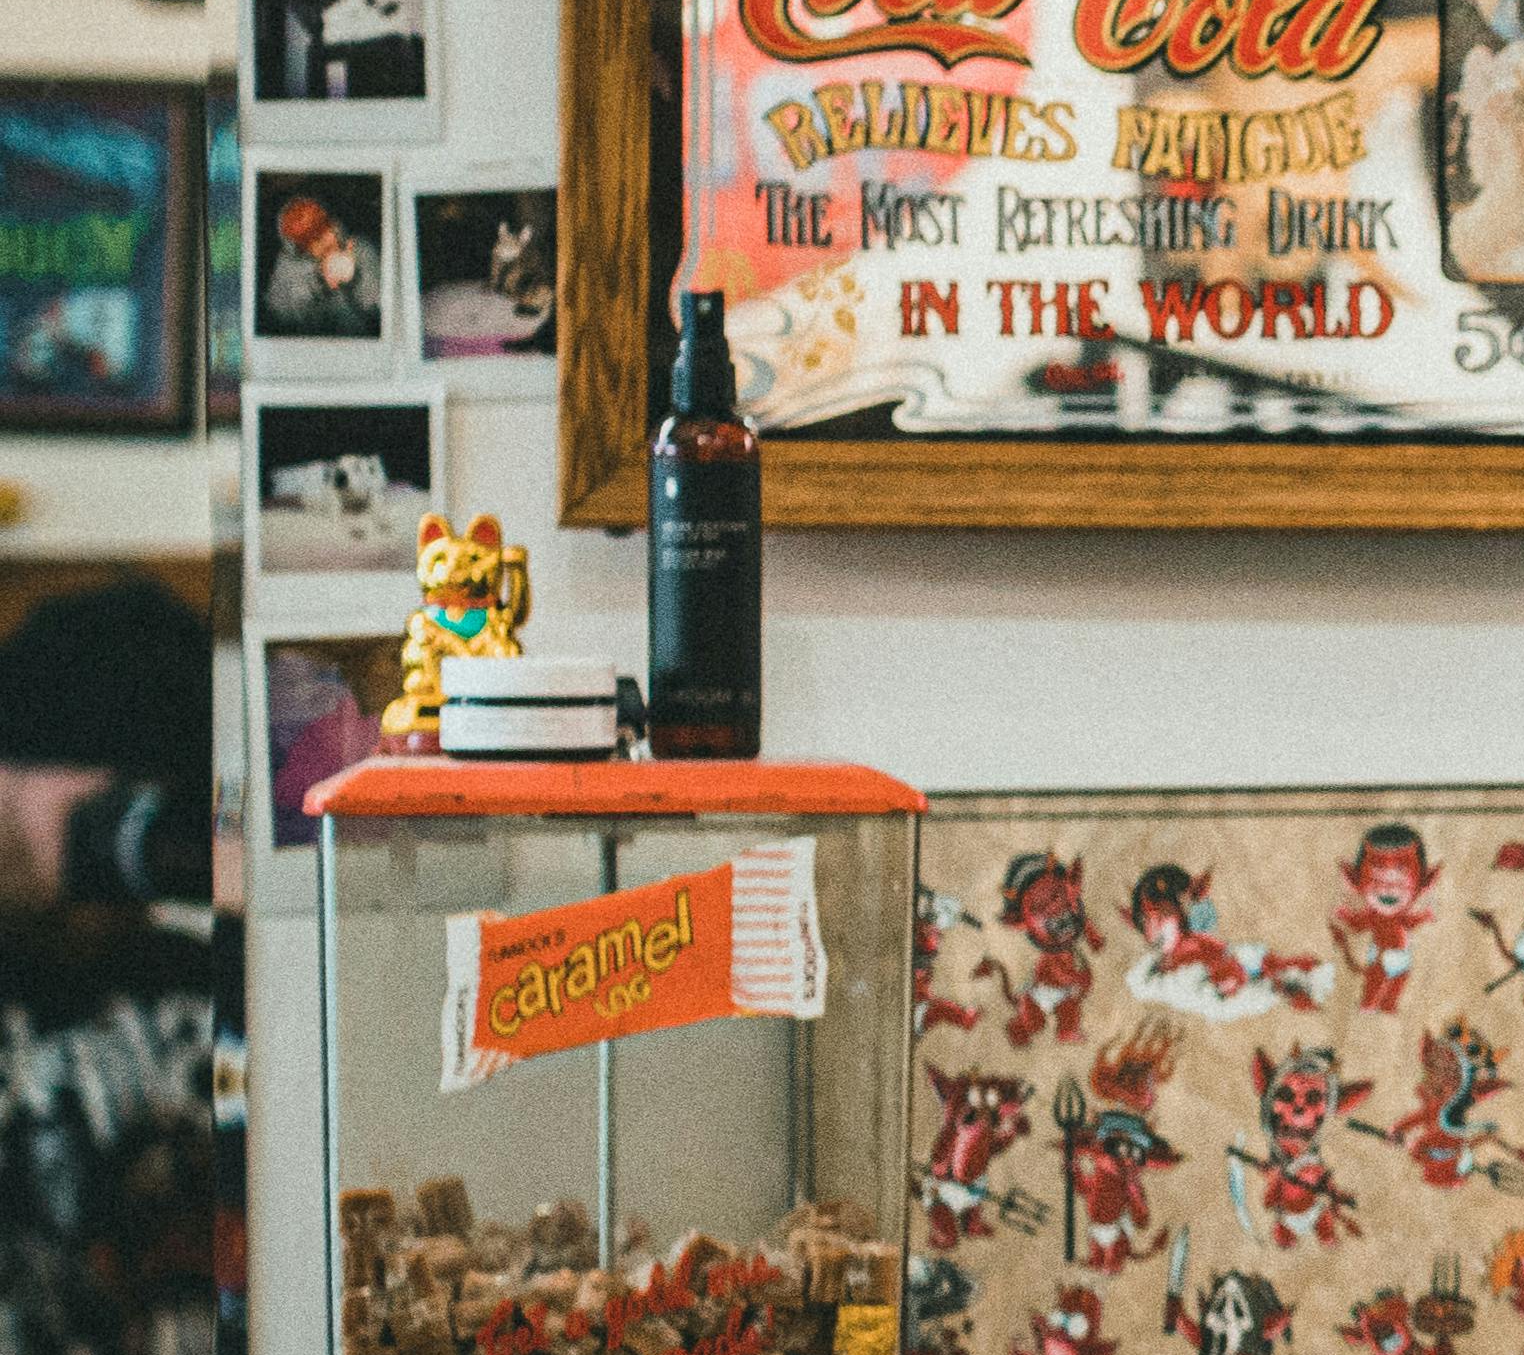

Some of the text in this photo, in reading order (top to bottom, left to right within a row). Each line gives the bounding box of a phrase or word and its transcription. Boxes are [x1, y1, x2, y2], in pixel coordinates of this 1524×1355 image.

[761, 80, 1369, 185] RELIEVES FATIGUE
[755, 178, 834, 249] THE
[995, 186, 1239, 254] REFRESHING
[1266, 186, 1401, 257] DRINK
[899, 278, 1396, 345] IN THE WORLD
[488, 887, 695, 1038] caramel
